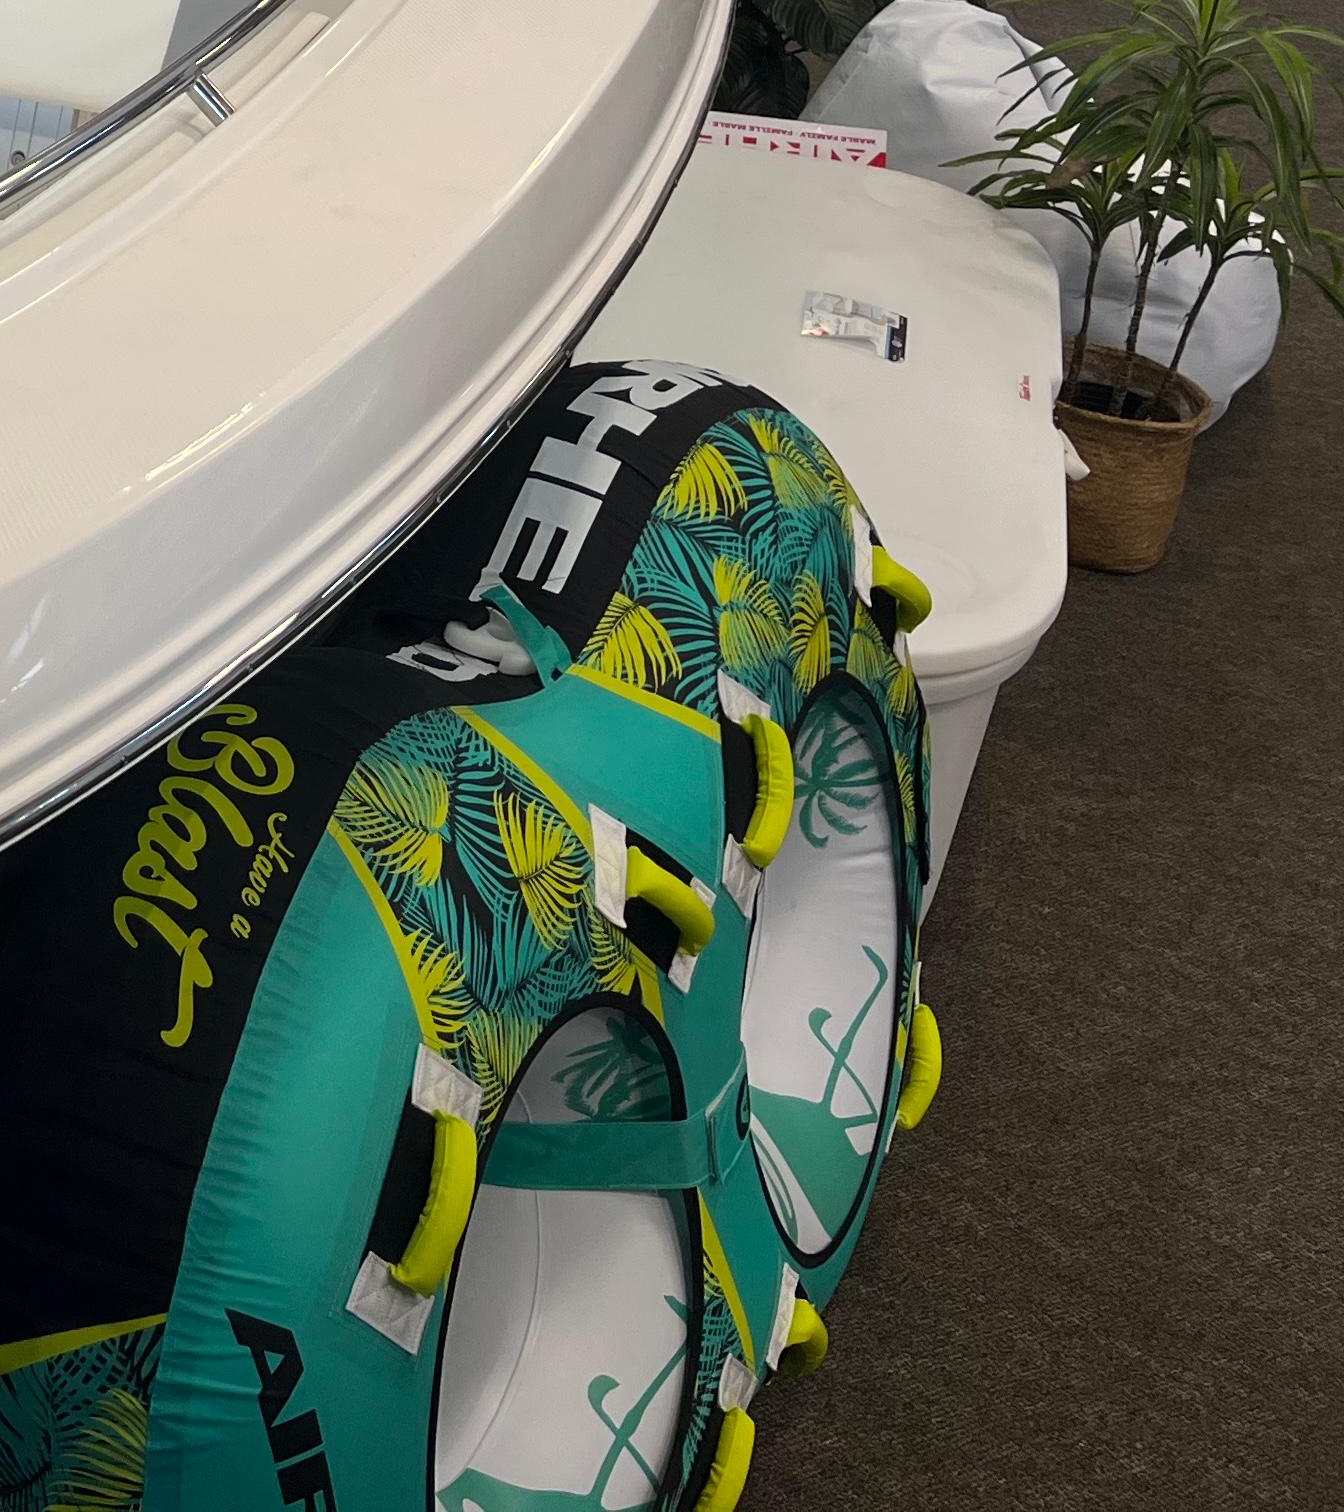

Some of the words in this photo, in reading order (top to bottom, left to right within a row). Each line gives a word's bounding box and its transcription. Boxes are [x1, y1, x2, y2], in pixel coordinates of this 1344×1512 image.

[113, 704, 295, 1048] Blast
[241, 812, 295, 907] Have
[230, 913, 252, 939] a
